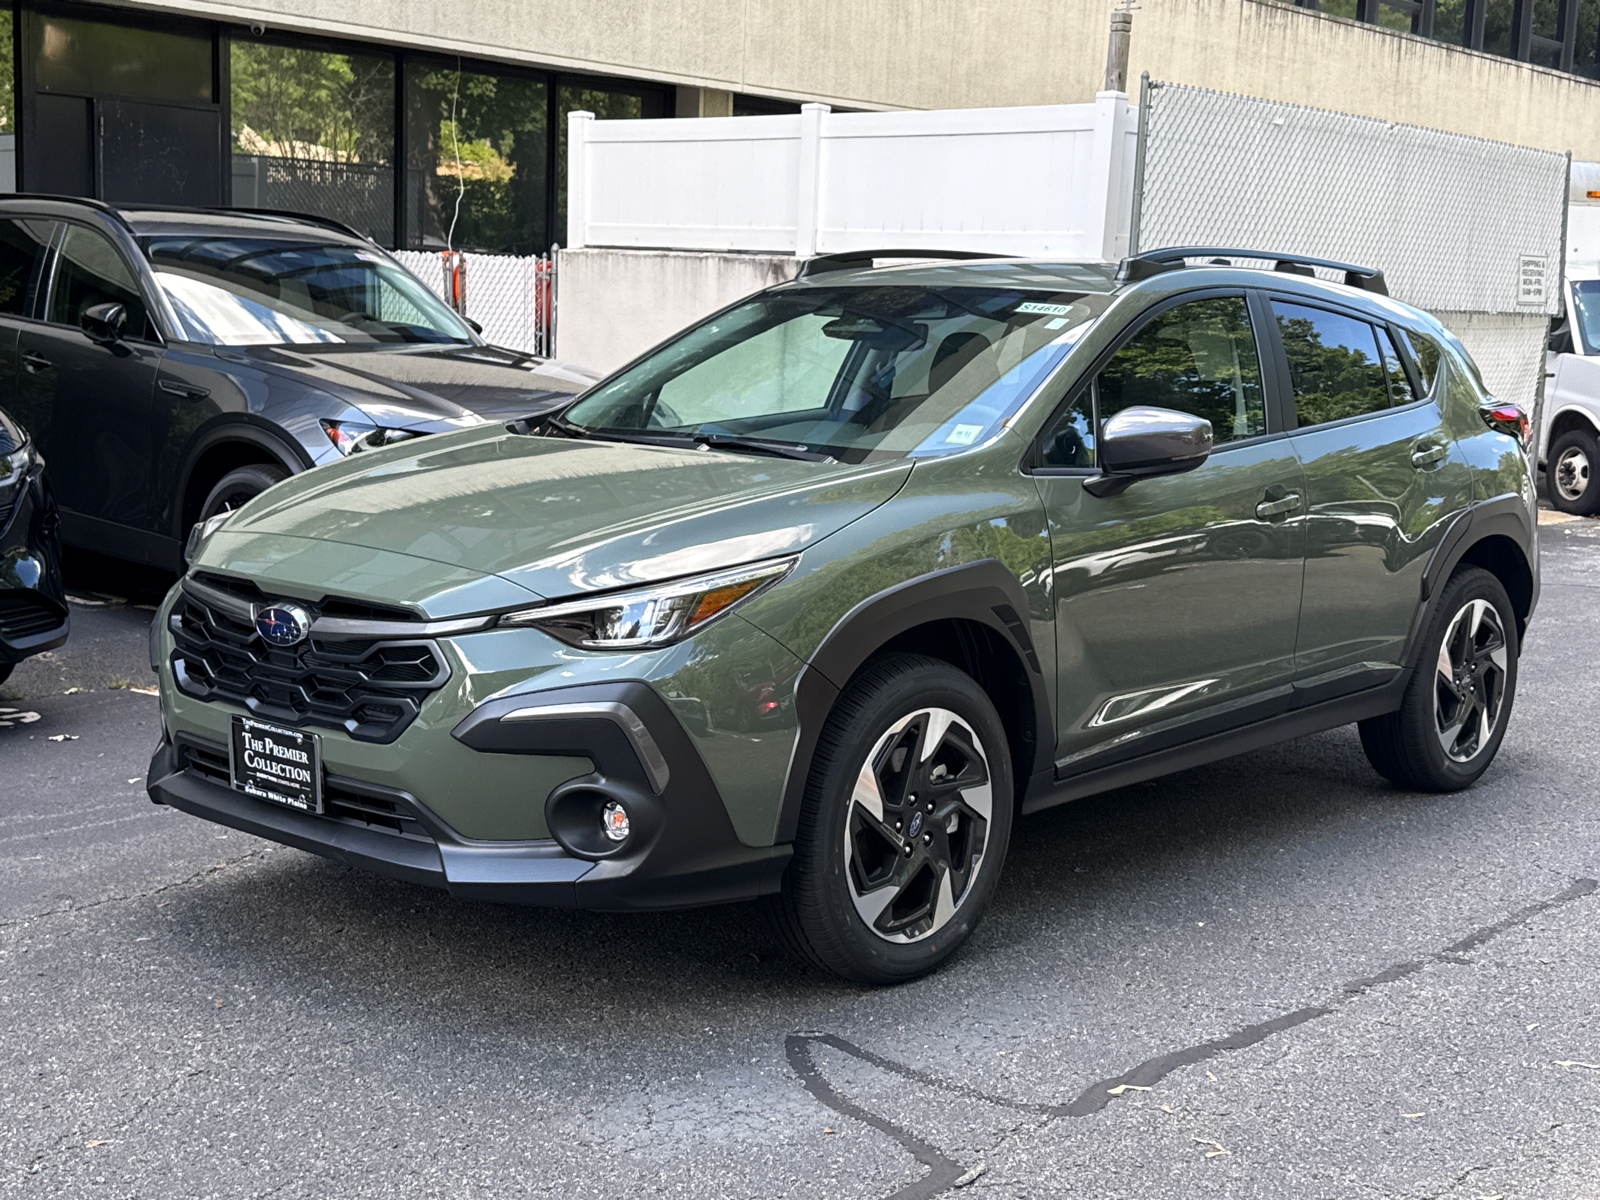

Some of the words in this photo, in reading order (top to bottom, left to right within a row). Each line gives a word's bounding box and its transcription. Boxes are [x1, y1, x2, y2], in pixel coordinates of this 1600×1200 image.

[1521, 259, 1541, 268] SHIPPING
[1522, 269, 1544, 277] RECEIVING
[1021, 304, 1067, 313] S14610
[264, 738, 309, 764] PREMIER
[244, 750, 311, 783] COLLECTION
[267, 791, 287, 804] White
[286, 797, 308, 810] Plains
